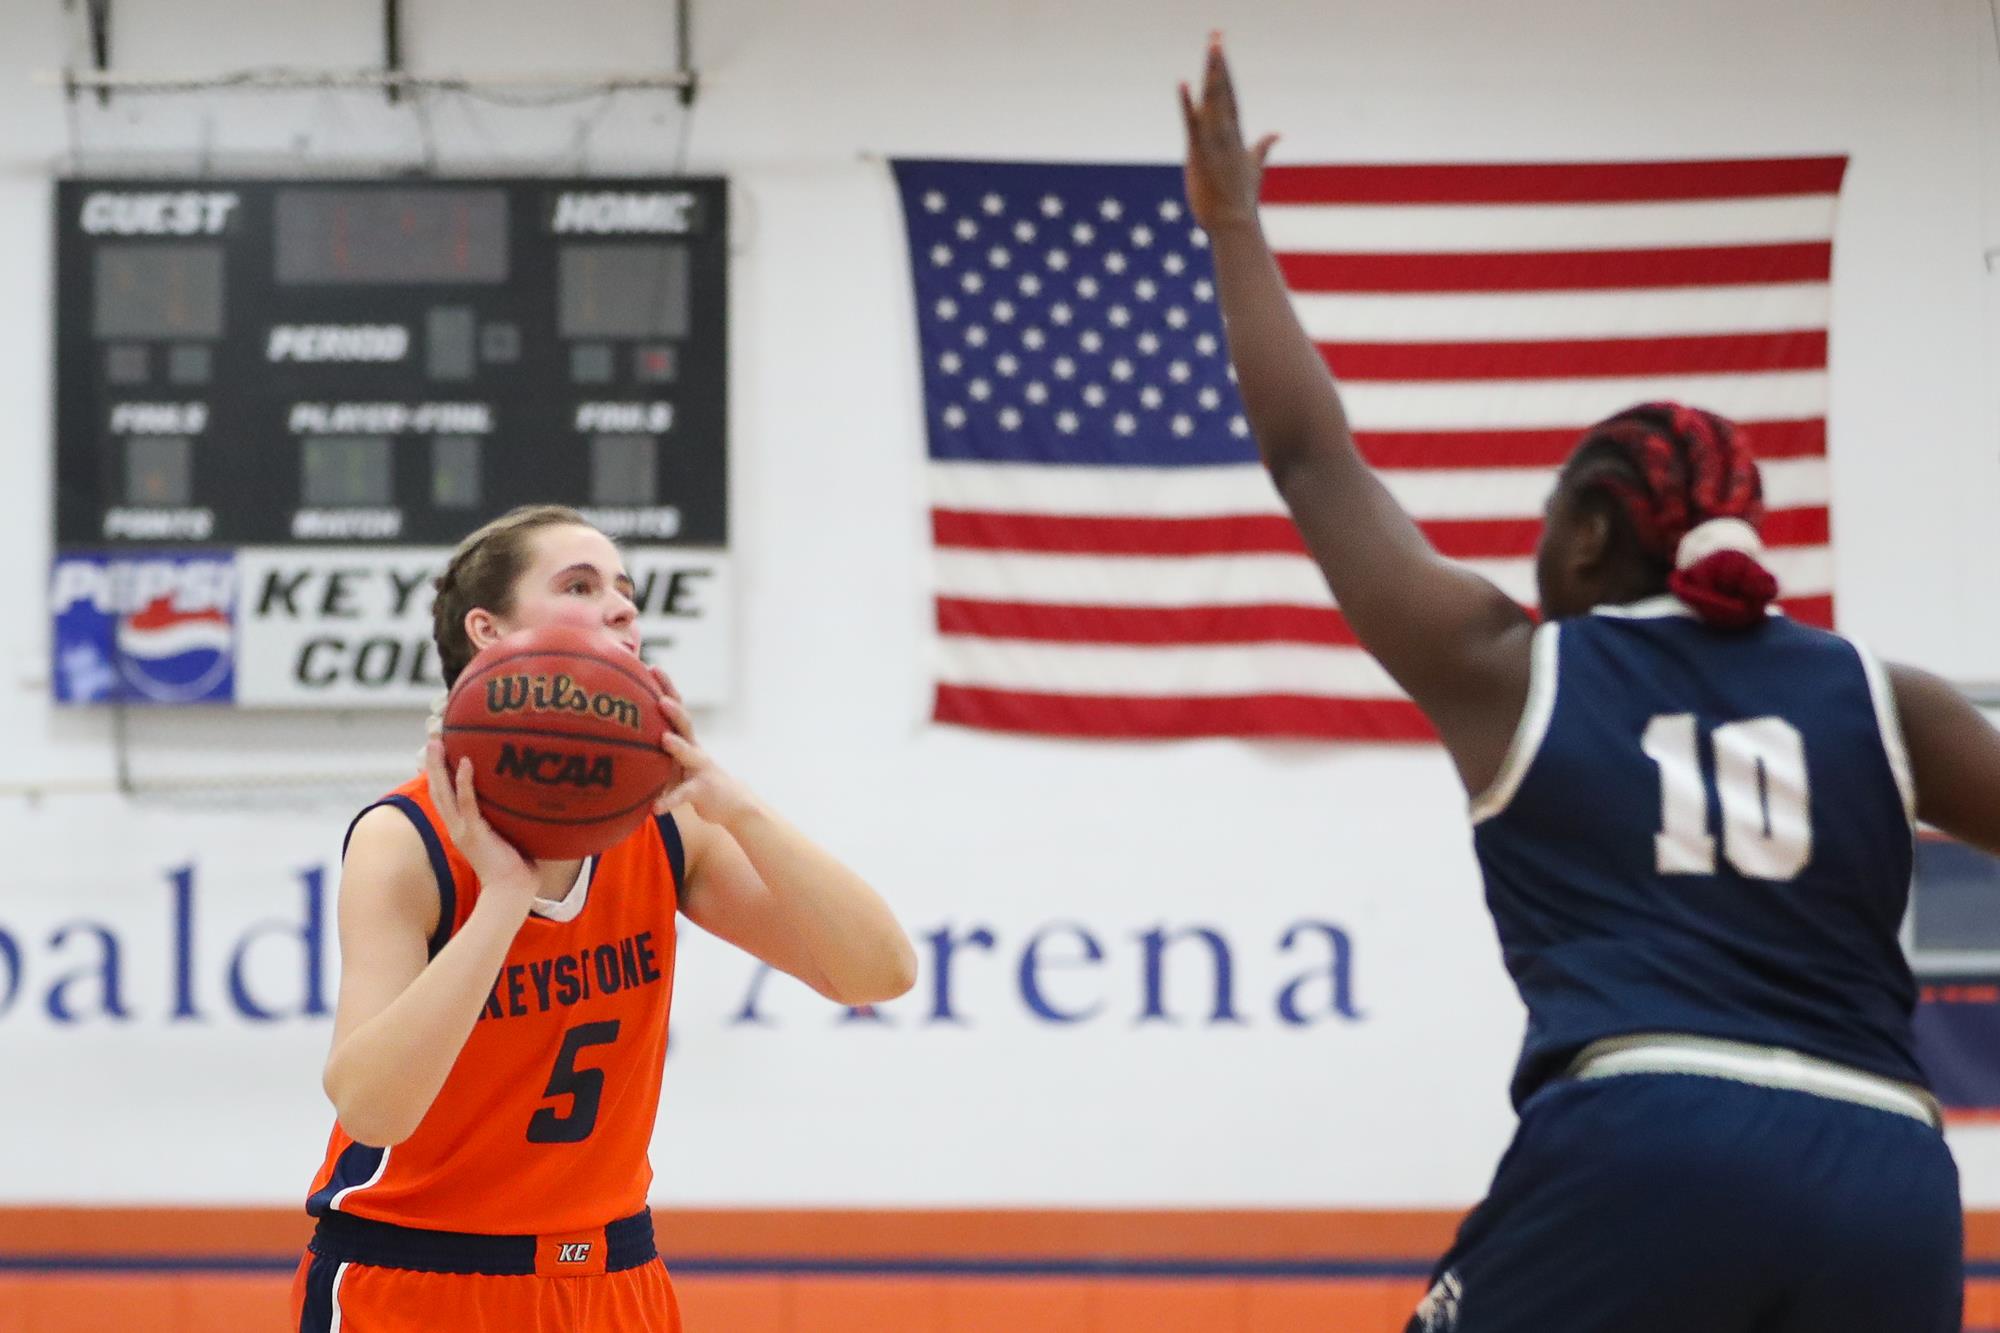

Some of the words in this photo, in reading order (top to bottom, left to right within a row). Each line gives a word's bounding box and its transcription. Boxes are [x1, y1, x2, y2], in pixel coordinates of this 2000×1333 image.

[80, 191, 240, 236] GUEST
[552, 191, 694, 234] HOME
[266, 323, 410, 363] PERIOD
[50, 561, 235, 616] PEPSI
[486, 674, 642, 731] Wilson
[495, 742, 616, 789] NCAA
[1639, 711, 1814, 883] 10
[478, 931, 662, 1021] KEYSTONE
[725, 917, 1368, 1028] rena
[525, 1019, 622, 1144] 5
[558, 1242, 592, 1263] KC
